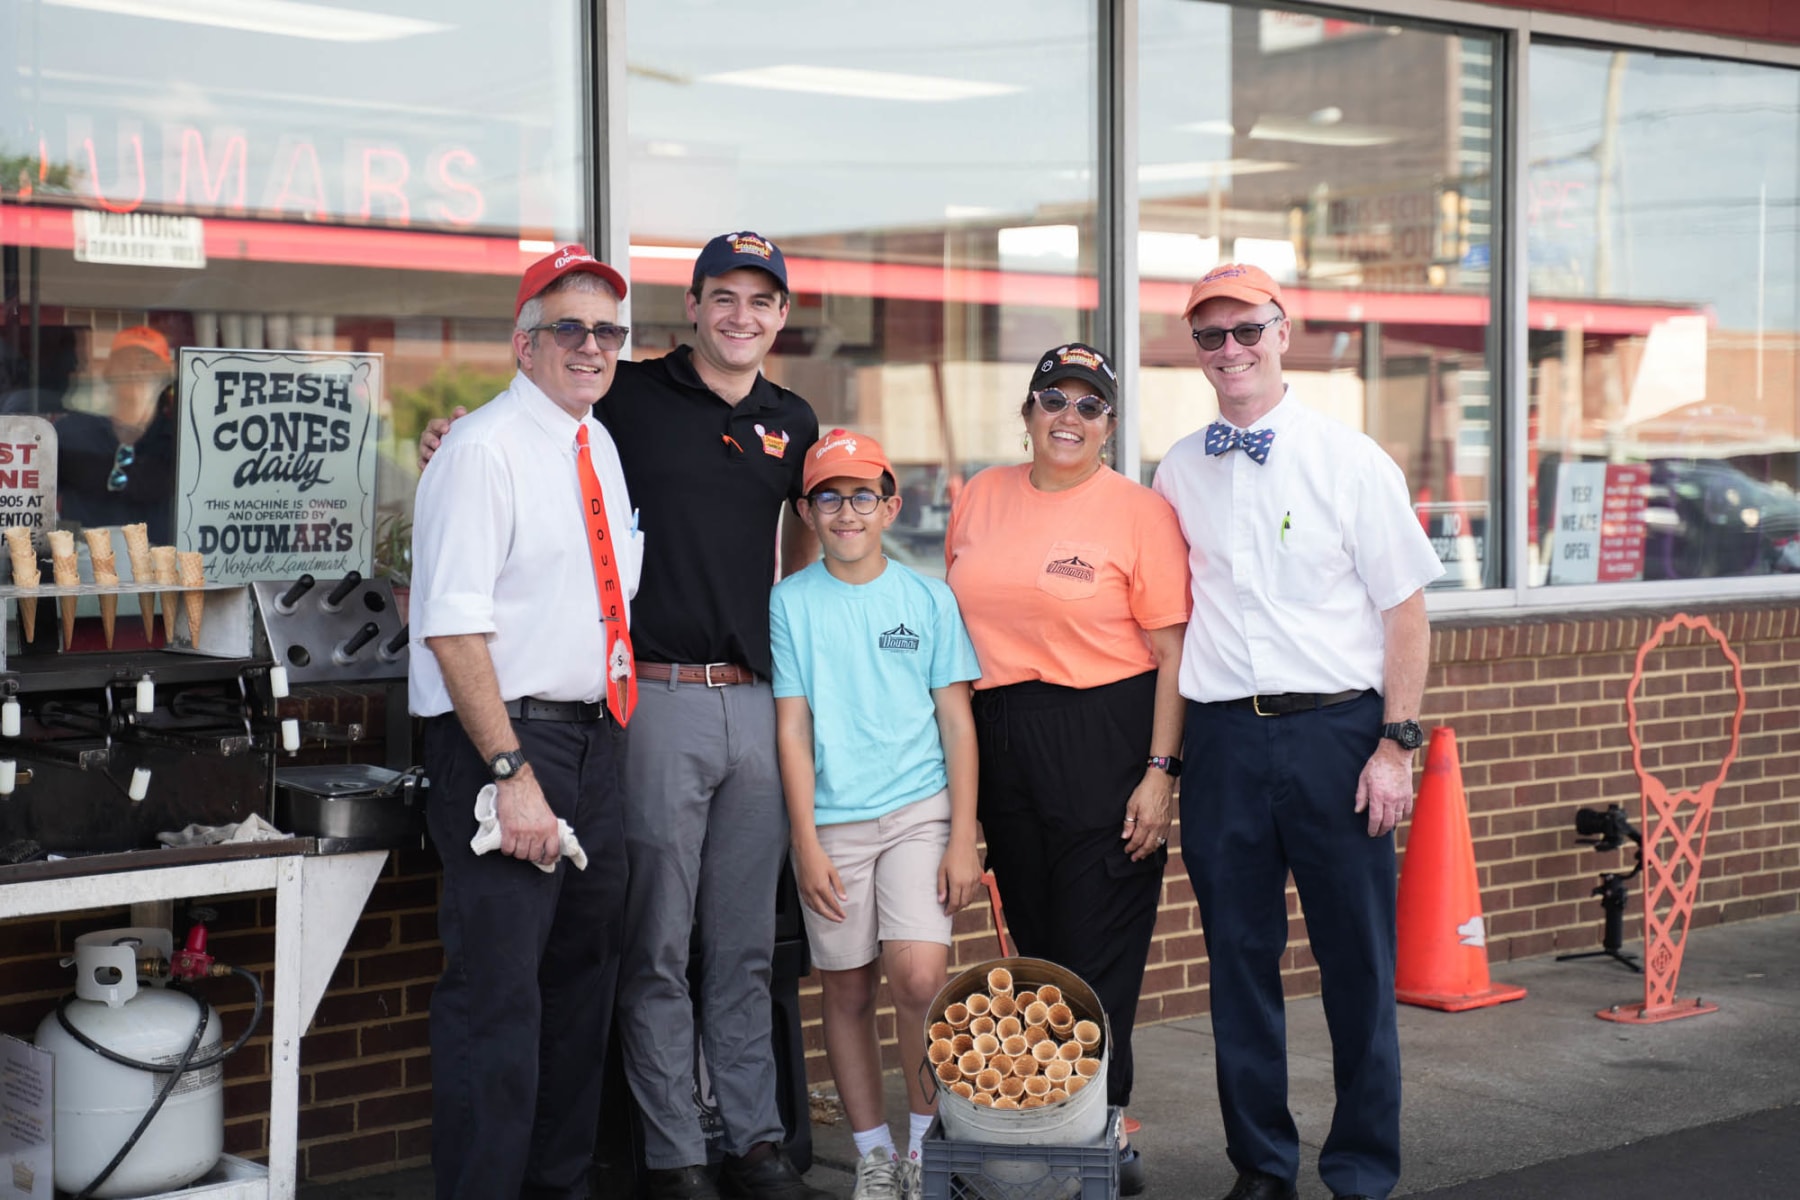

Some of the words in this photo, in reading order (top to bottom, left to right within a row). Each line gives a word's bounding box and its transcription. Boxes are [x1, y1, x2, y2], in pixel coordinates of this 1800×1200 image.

[20, 114, 488, 228] UMARS
[214, 371, 352, 415] FRESH
[213, 412, 350, 452] CONES
[0, 443, 38, 465] ST
[0, 470, 39, 489] NE
[233, 447, 334, 492] daily
[27, 495, 44, 508] AT
[204, 499, 230, 510] THIS
[234, 499, 289, 510] MACHINE
[293, 499, 303, 510] IS
[308, 499, 347, 509] OWNED
[226, 510, 252, 521] AND
[255, 510, 309, 521] OPERATED
[311, 510, 327, 520] BY
[1442, 513, 1462, 537] NO
[198, 517, 353, 555] DOUMAR'S
[1564, 542, 1591, 560] OPEN
[203, 557, 216, 575] A
[218, 554, 274, 578] Norfolk
[277, 554, 350, 573] Landmark
